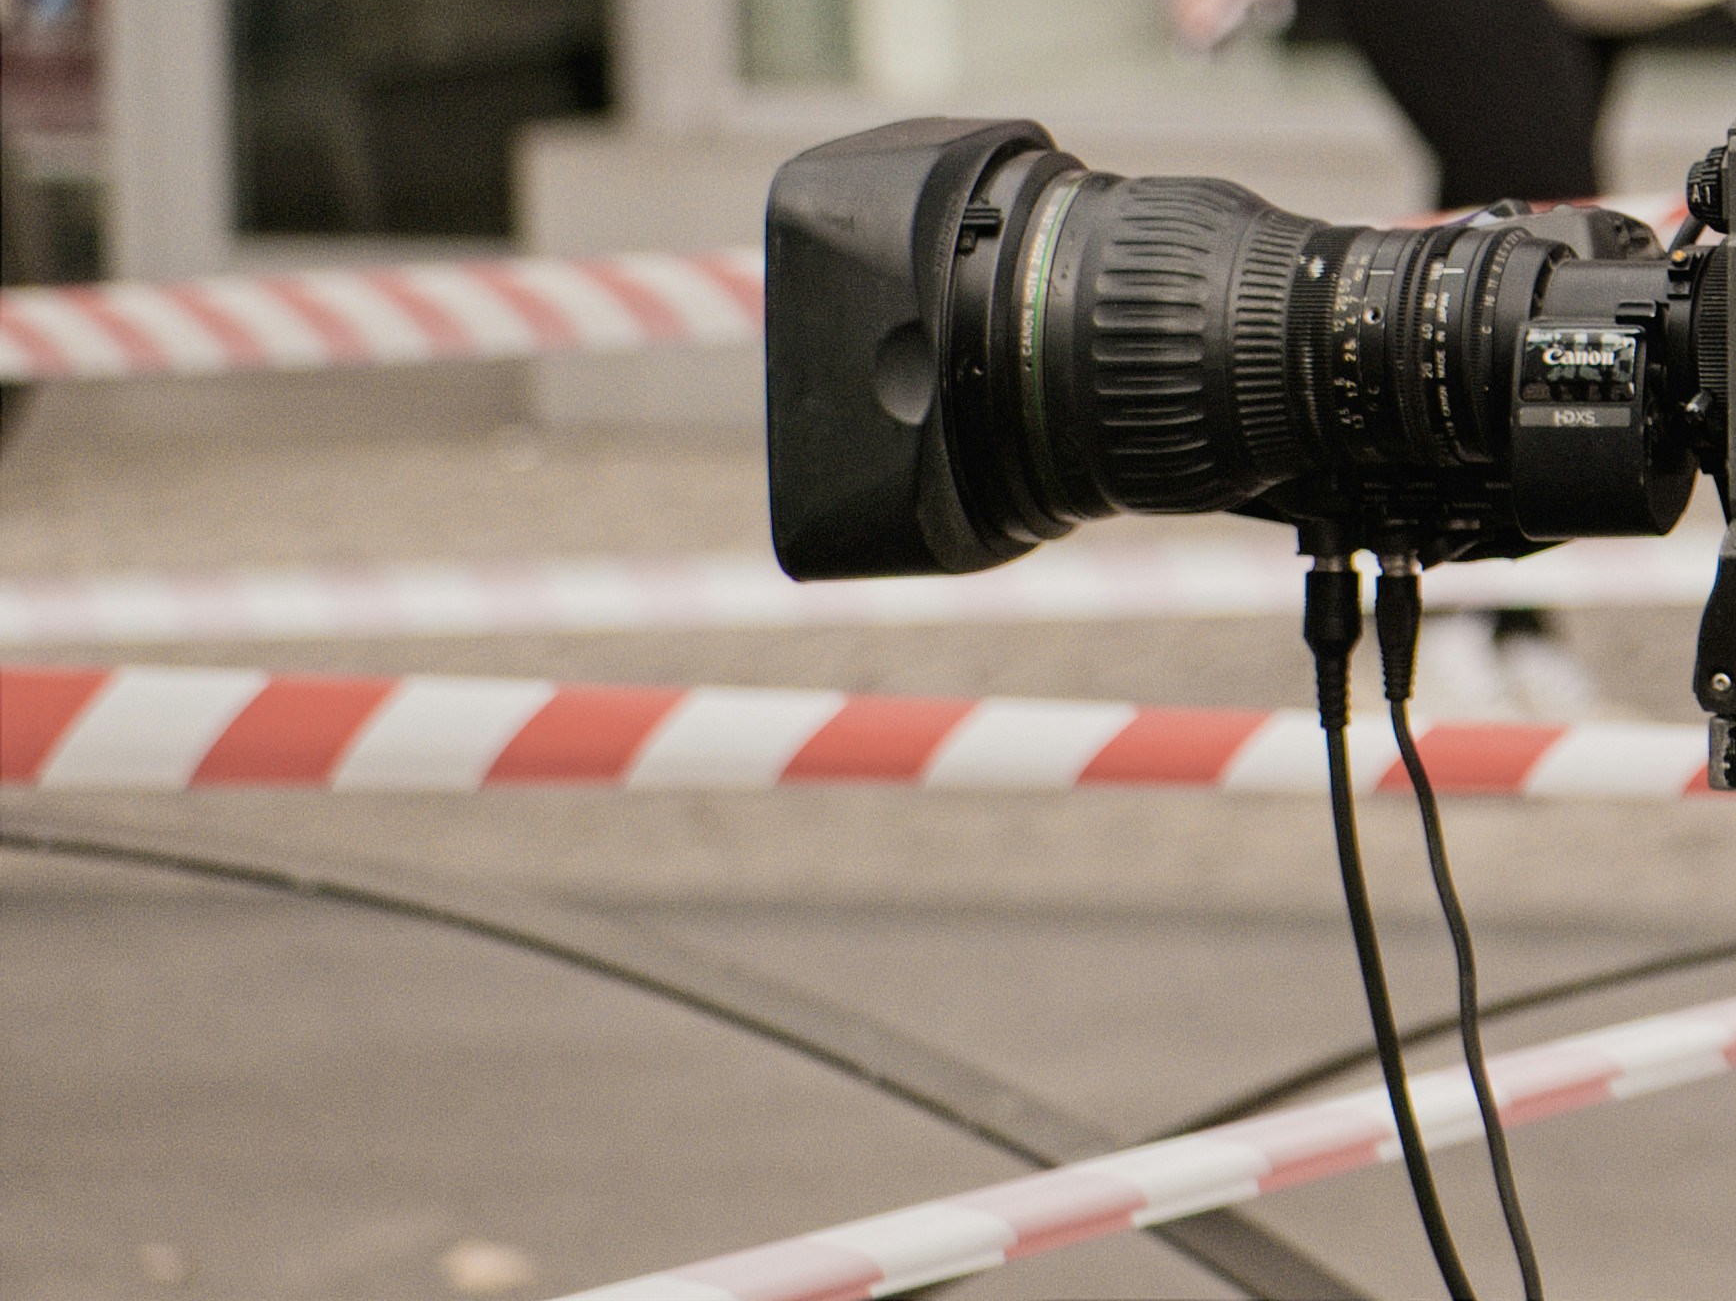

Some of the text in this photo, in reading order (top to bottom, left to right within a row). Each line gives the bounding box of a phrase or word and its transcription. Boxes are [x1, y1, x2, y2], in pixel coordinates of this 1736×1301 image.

[1021, 308, 1036, 356] CANON
[1420, 323, 1434, 340] 40
[1481, 325, 1493, 335] C
[1542, 347, 1616, 367] Canon
[1420, 362, 1434, 379] 20
